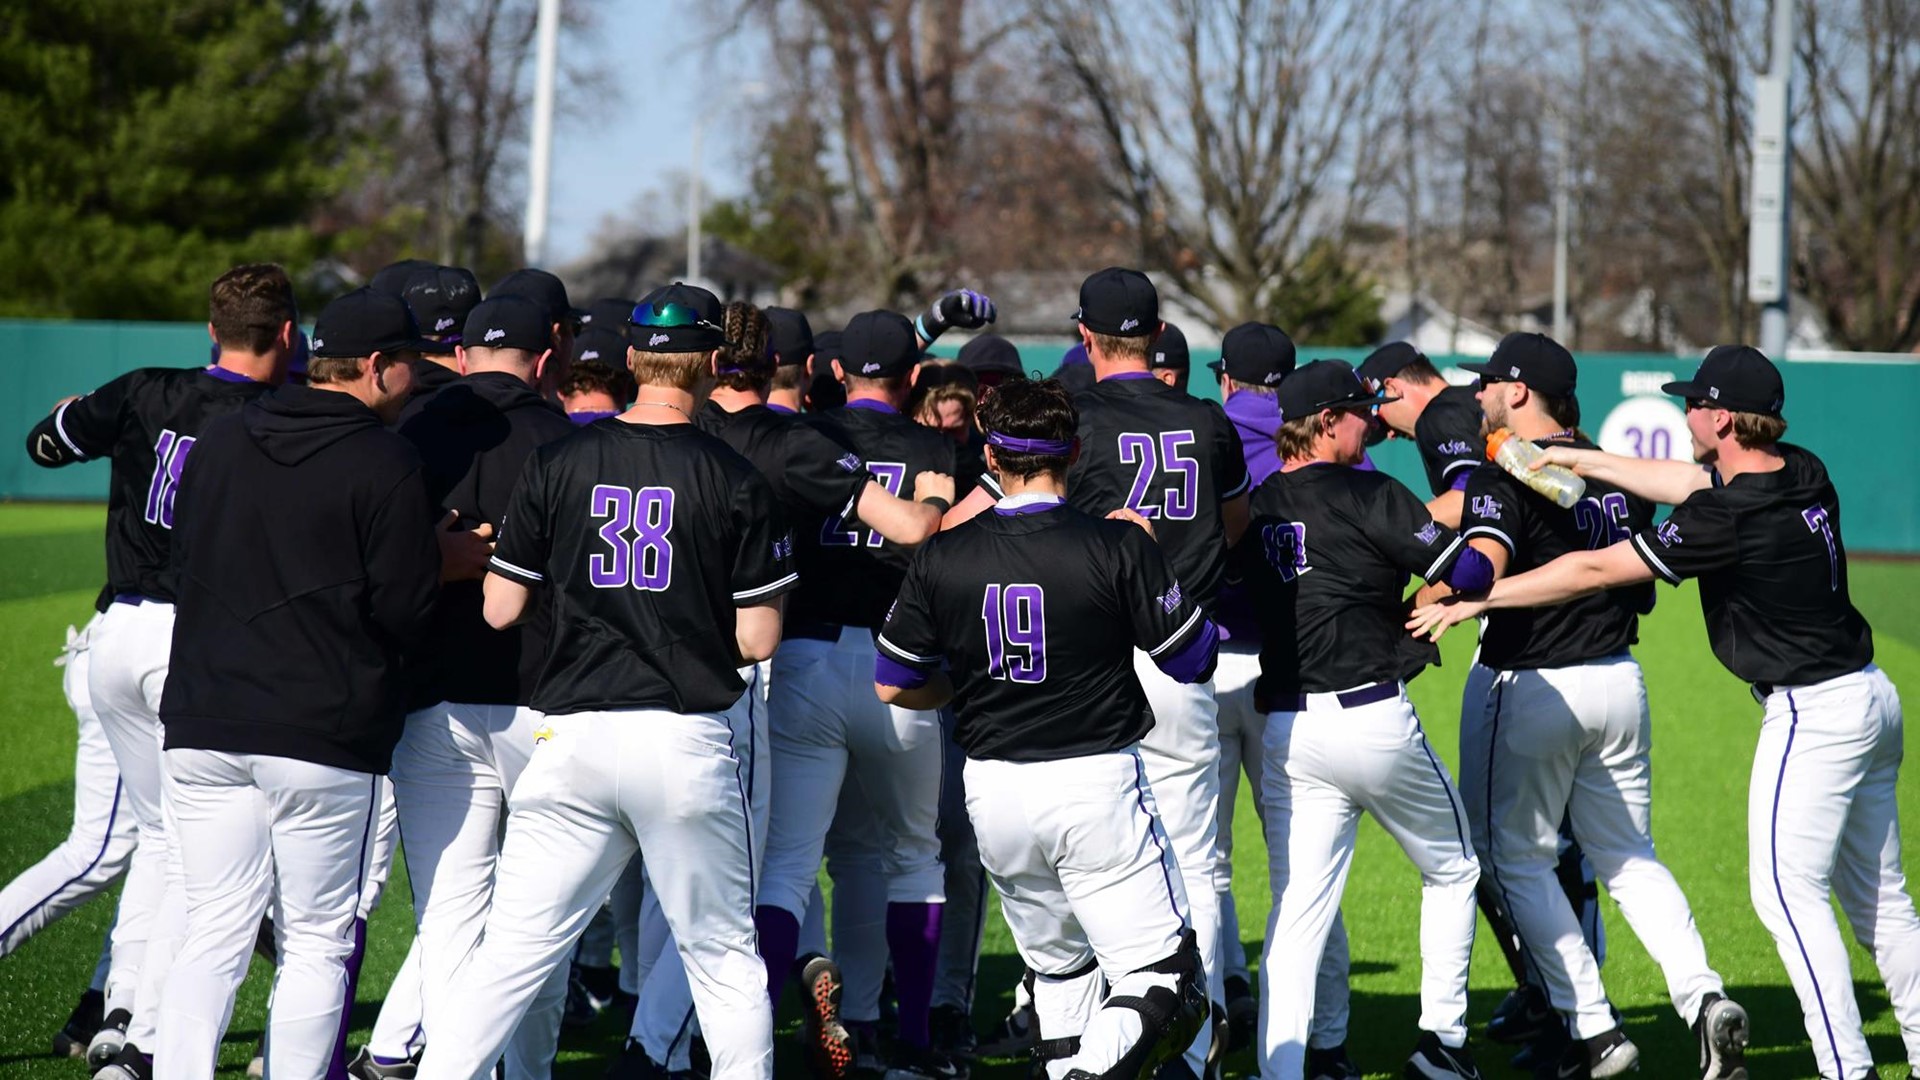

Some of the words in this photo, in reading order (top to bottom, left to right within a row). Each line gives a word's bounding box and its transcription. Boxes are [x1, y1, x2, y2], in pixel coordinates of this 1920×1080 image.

[1117, 429, 1199, 520] 25
[1625, 426, 1671, 459] 30
[589, 484, 675, 592] 38
[1472, 494, 1503, 520] UE
[1573, 491, 1632, 551] 26
[1801, 503, 1838, 593] 7
[981, 583, 1047, 684] 19
